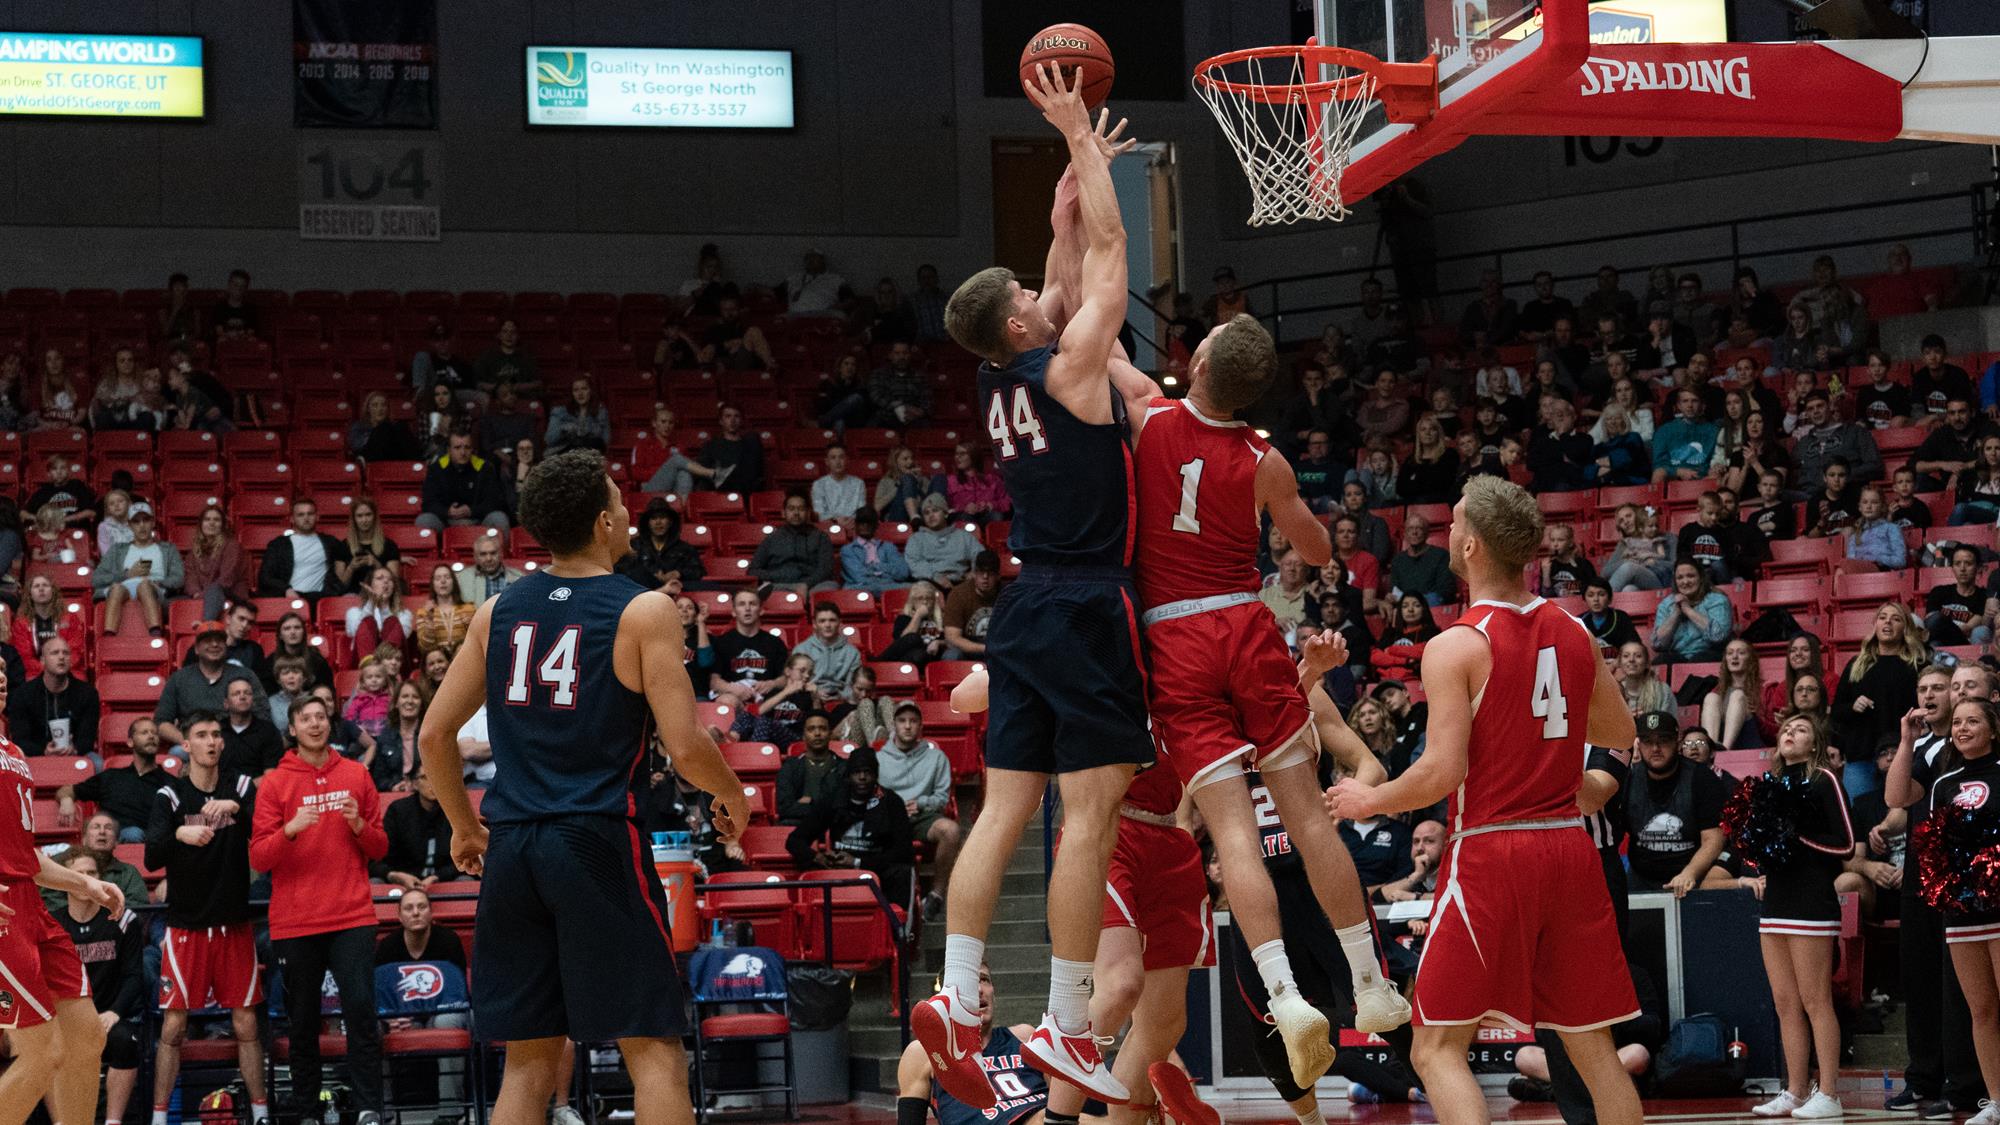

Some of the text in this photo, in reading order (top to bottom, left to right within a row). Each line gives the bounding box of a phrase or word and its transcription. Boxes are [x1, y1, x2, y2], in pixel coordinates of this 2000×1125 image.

[91, 41, 176, 64] WORLD
[308, 42, 423, 60] NCAA REGIONALS
[1031, 34, 1090, 55] Wilson
[299, 63, 325, 78] 2013
[334, 64, 360, 79] 2014
[369, 64, 395, 80] 2015
[590, 61, 785, 78] Quality Inn Washington
[1580, 56, 1752, 99] SPALDING
[14, 75, 42, 88] Drive
[46, 73, 66, 89] ST.
[146, 75, 167, 90] UT
[621, 82, 756, 97] St George North
[631, 102, 748, 117] 435-673-3537
[307, 148, 431, 200] 104
[303, 209, 438, 238] RESERVED SEATING
[987, 383, 1049, 461] 44
[1171, 457, 1206, 535] 1
[505, 621, 582, 710] 14
[1531, 645, 1568, 740] 4
